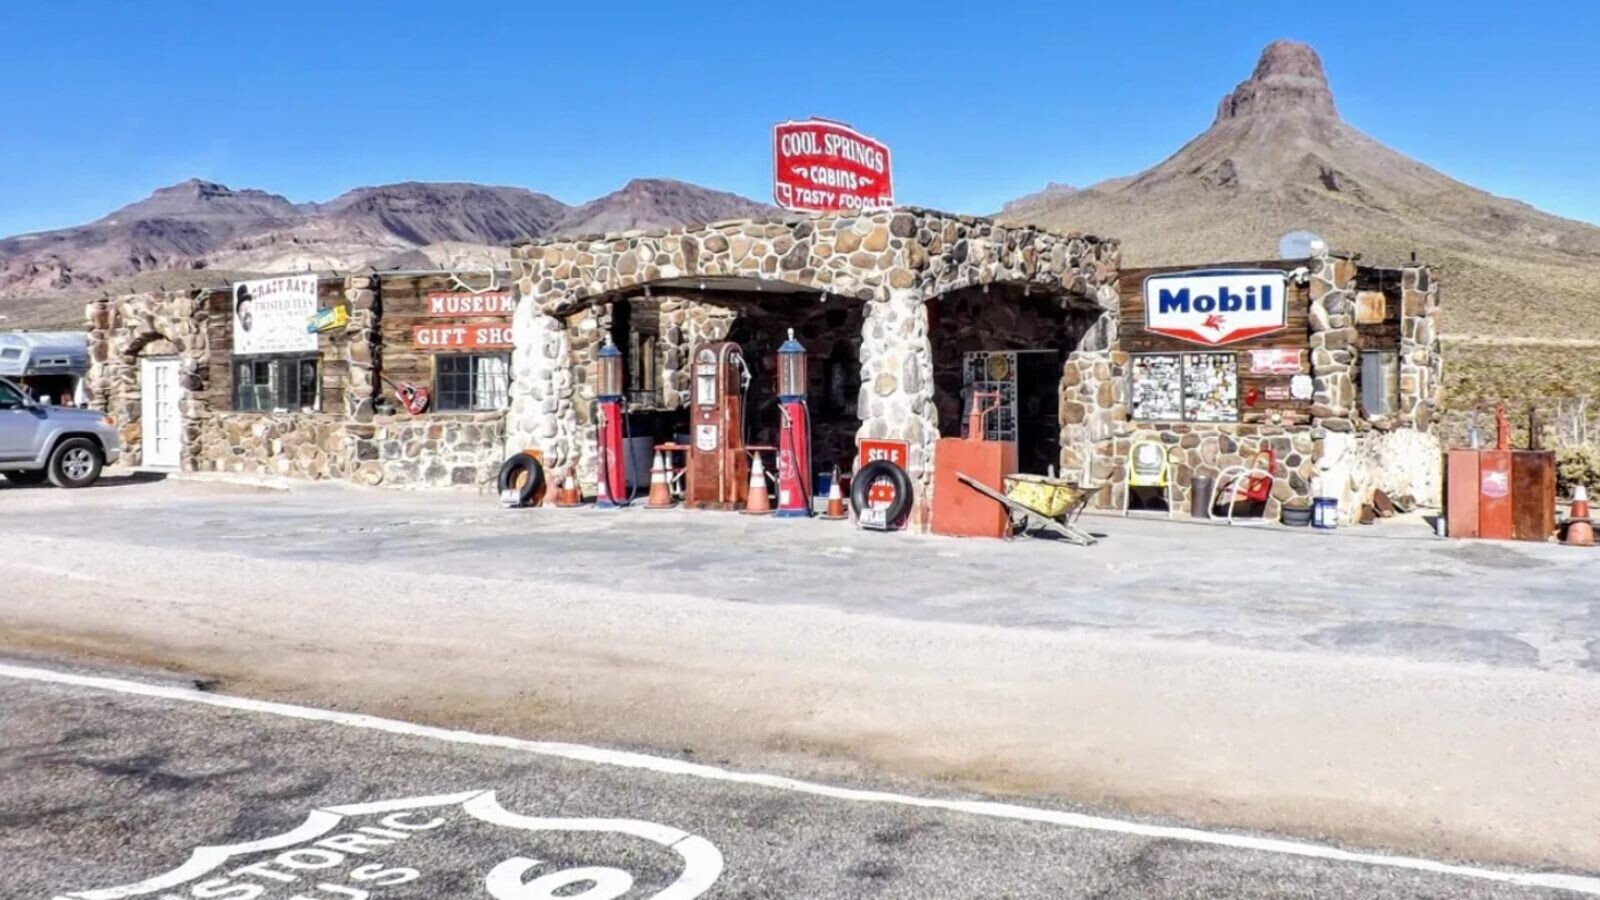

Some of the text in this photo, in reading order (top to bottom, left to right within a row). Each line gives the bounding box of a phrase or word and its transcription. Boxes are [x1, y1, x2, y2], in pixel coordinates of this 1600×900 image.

[781, 132, 884, 174] COOL SPRINGS
[811, 166, 858, 190] CABINS
[795, 187, 876, 209] TASTY FOODS
[431, 295, 516, 313] MUSEUM
[1158, 285, 1272, 314] Mobil
[416, 327, 466, 345] GIFT
